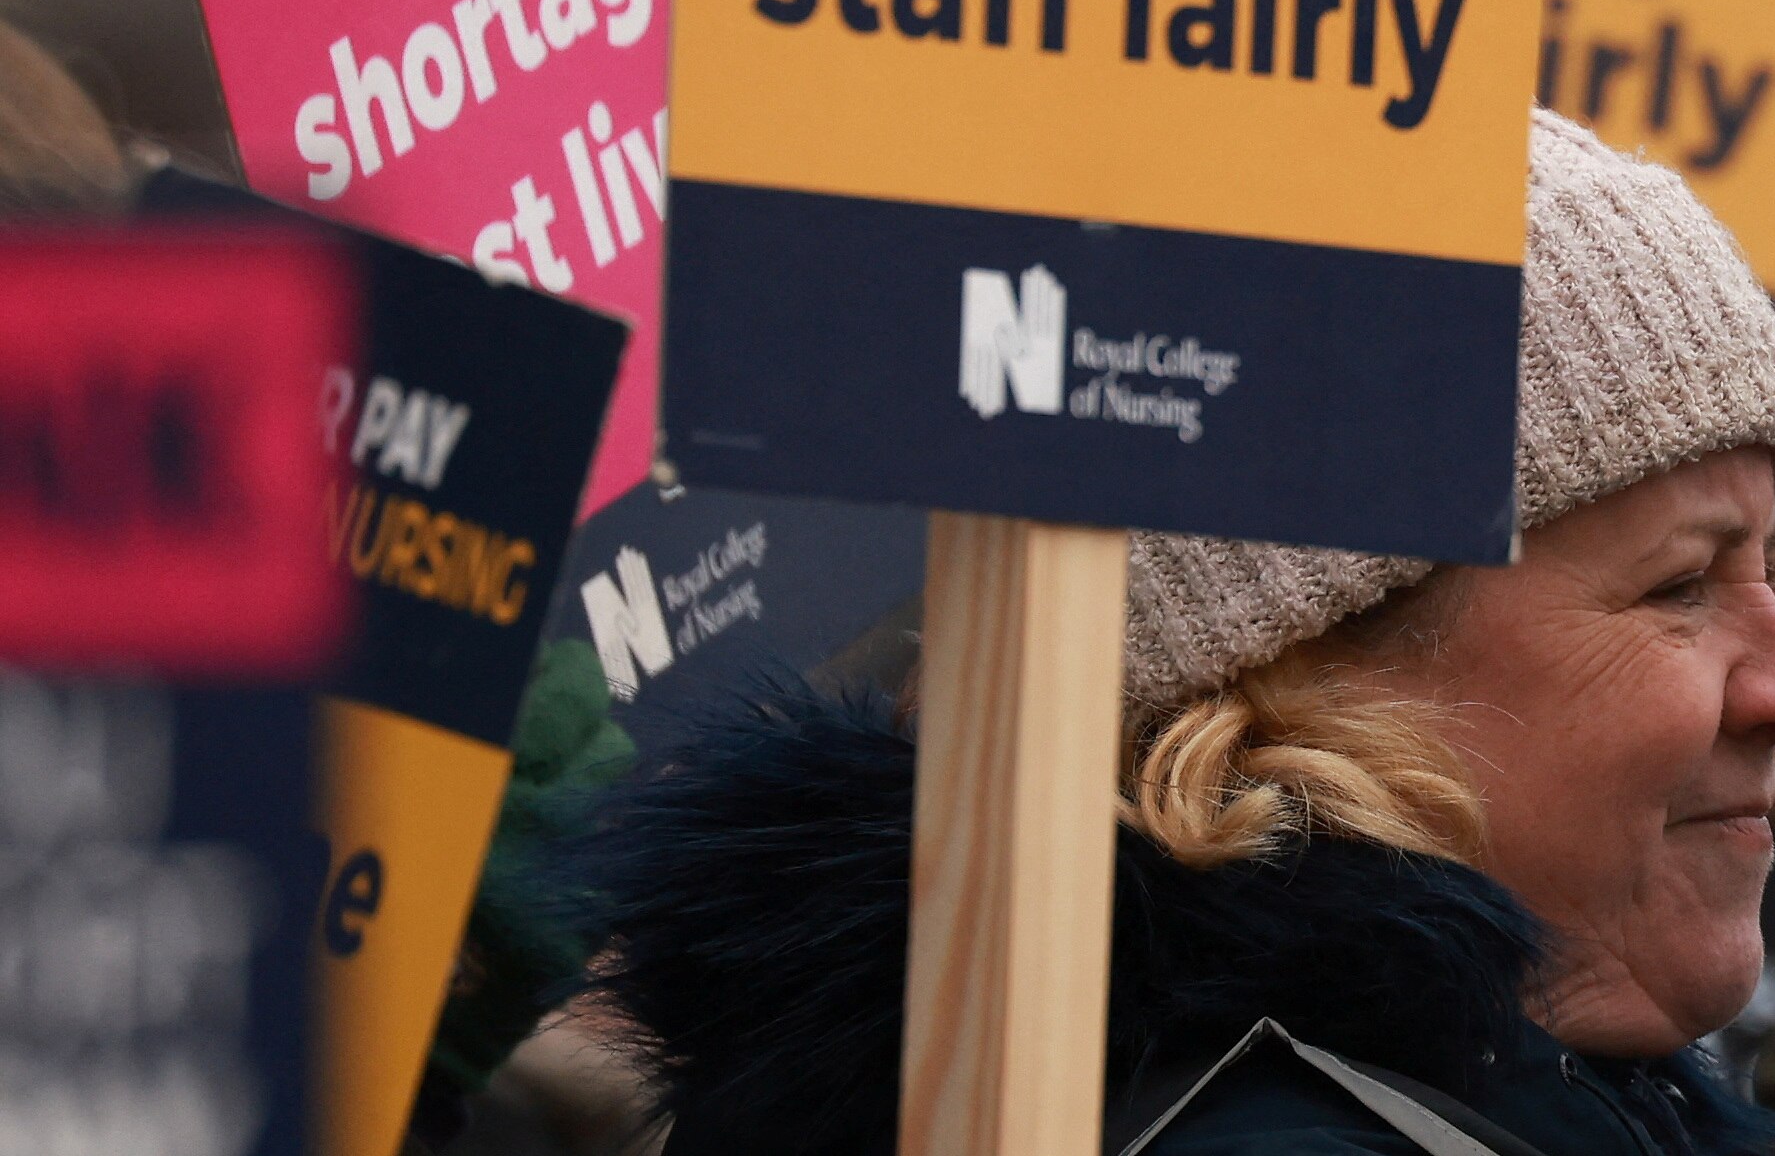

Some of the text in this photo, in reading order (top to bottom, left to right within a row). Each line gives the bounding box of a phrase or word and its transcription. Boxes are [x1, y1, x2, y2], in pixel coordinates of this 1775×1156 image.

[440, 174, 574, 294] st
[1073, 326, 1241, 396] Royal College
[351, 375, 470, 490] PAY
[1069, 377, 1203, 444] of Nursing
[663, 522, 766, 612] Royal College
[676, 579, 762, 655] of Nursing
